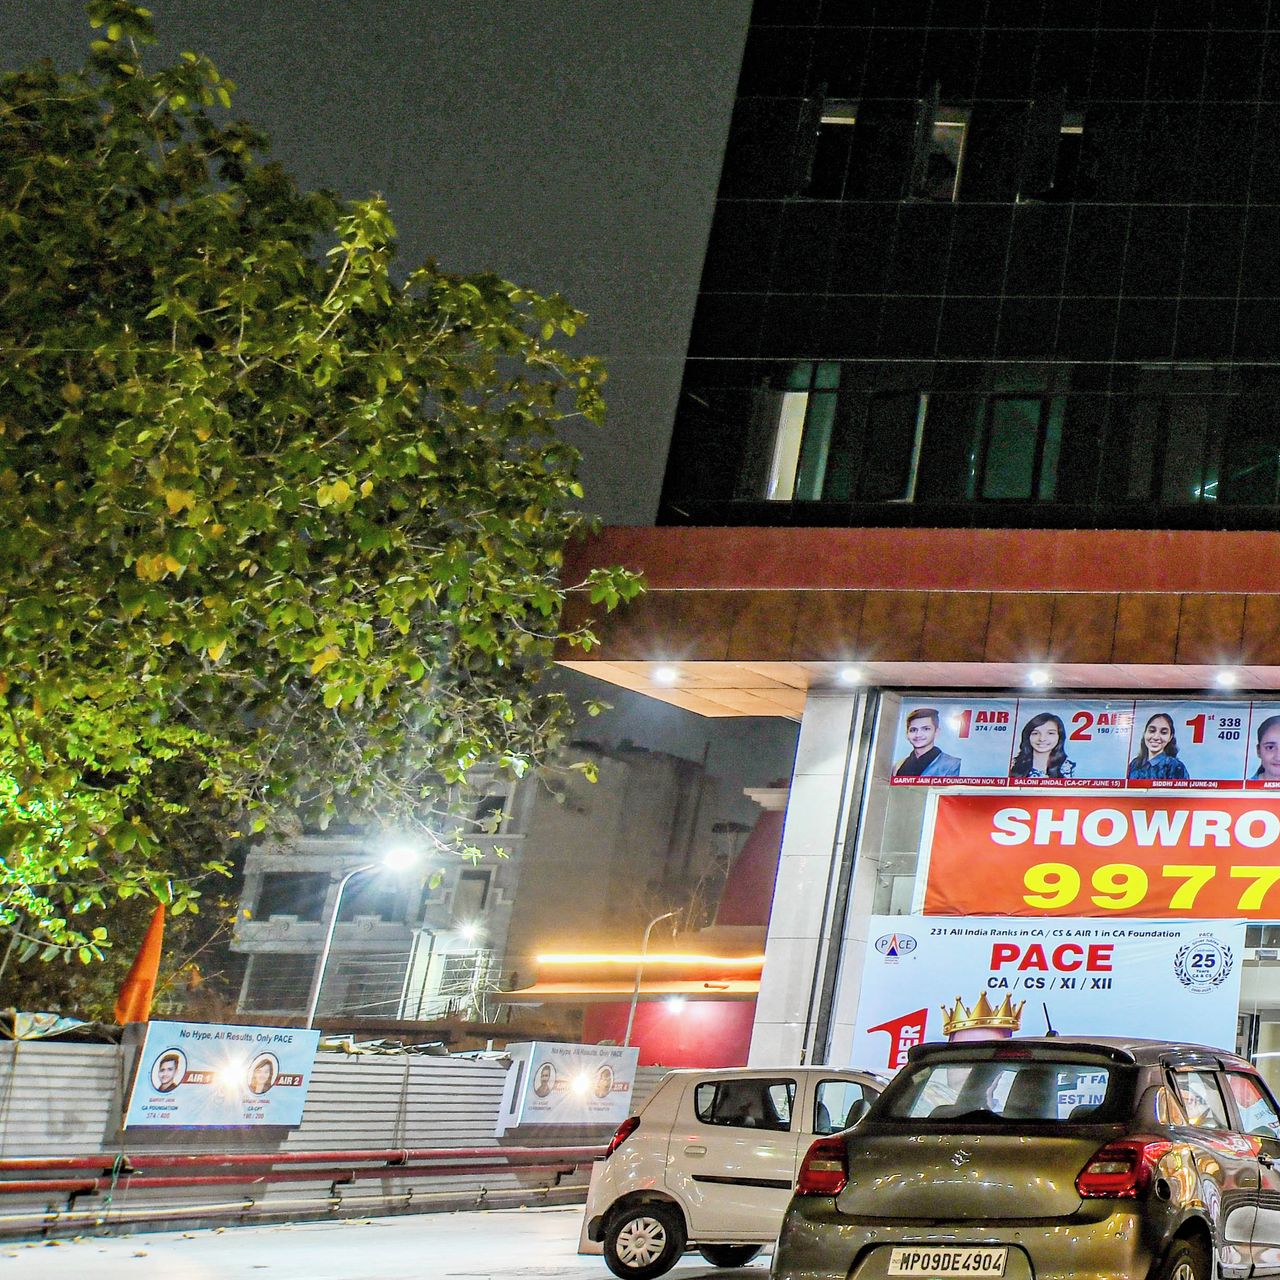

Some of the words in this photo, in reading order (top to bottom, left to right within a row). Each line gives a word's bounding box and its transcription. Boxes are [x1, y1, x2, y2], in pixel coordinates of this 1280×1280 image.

[953, 709, 972, 738] 1
[976, 711, 1009, 723] AIR
[1070, 711, 1092, 740] 2
[1219, 718, 1241, 728] 338
[1218, 730, 1240, 740] 400
[950, 928, 963, 936] All
[990, 943, 1114, 972] PACE
[1191, 954, 1216, 968] 25
[987, 977, 1008, 989] CA
[1013, 977, 1020, 990] /
[1024, 977, 1045, 989] CS
[1050, 977, 1056, 990] /
[1060, 978, 1076, 989] XI
[1080, 978, 1087, 990] /
[1091, 978, 1112, 989] XII
[180, 1030, 190, 1038] No
[192, 1031, 212, 1040] Hype,
[226, 1032, 254, 1042] Results,
[257, 1034, 272, 1044] Only
[274, 1034, 293, 1043] PACE
[188, 1074, 205, 1082] AIR
[278, 1077, 292, 1085] AIR
[293, 1077, 299, 1085] 2
[900, 1253, 1002, 1271] MP09DE4904
